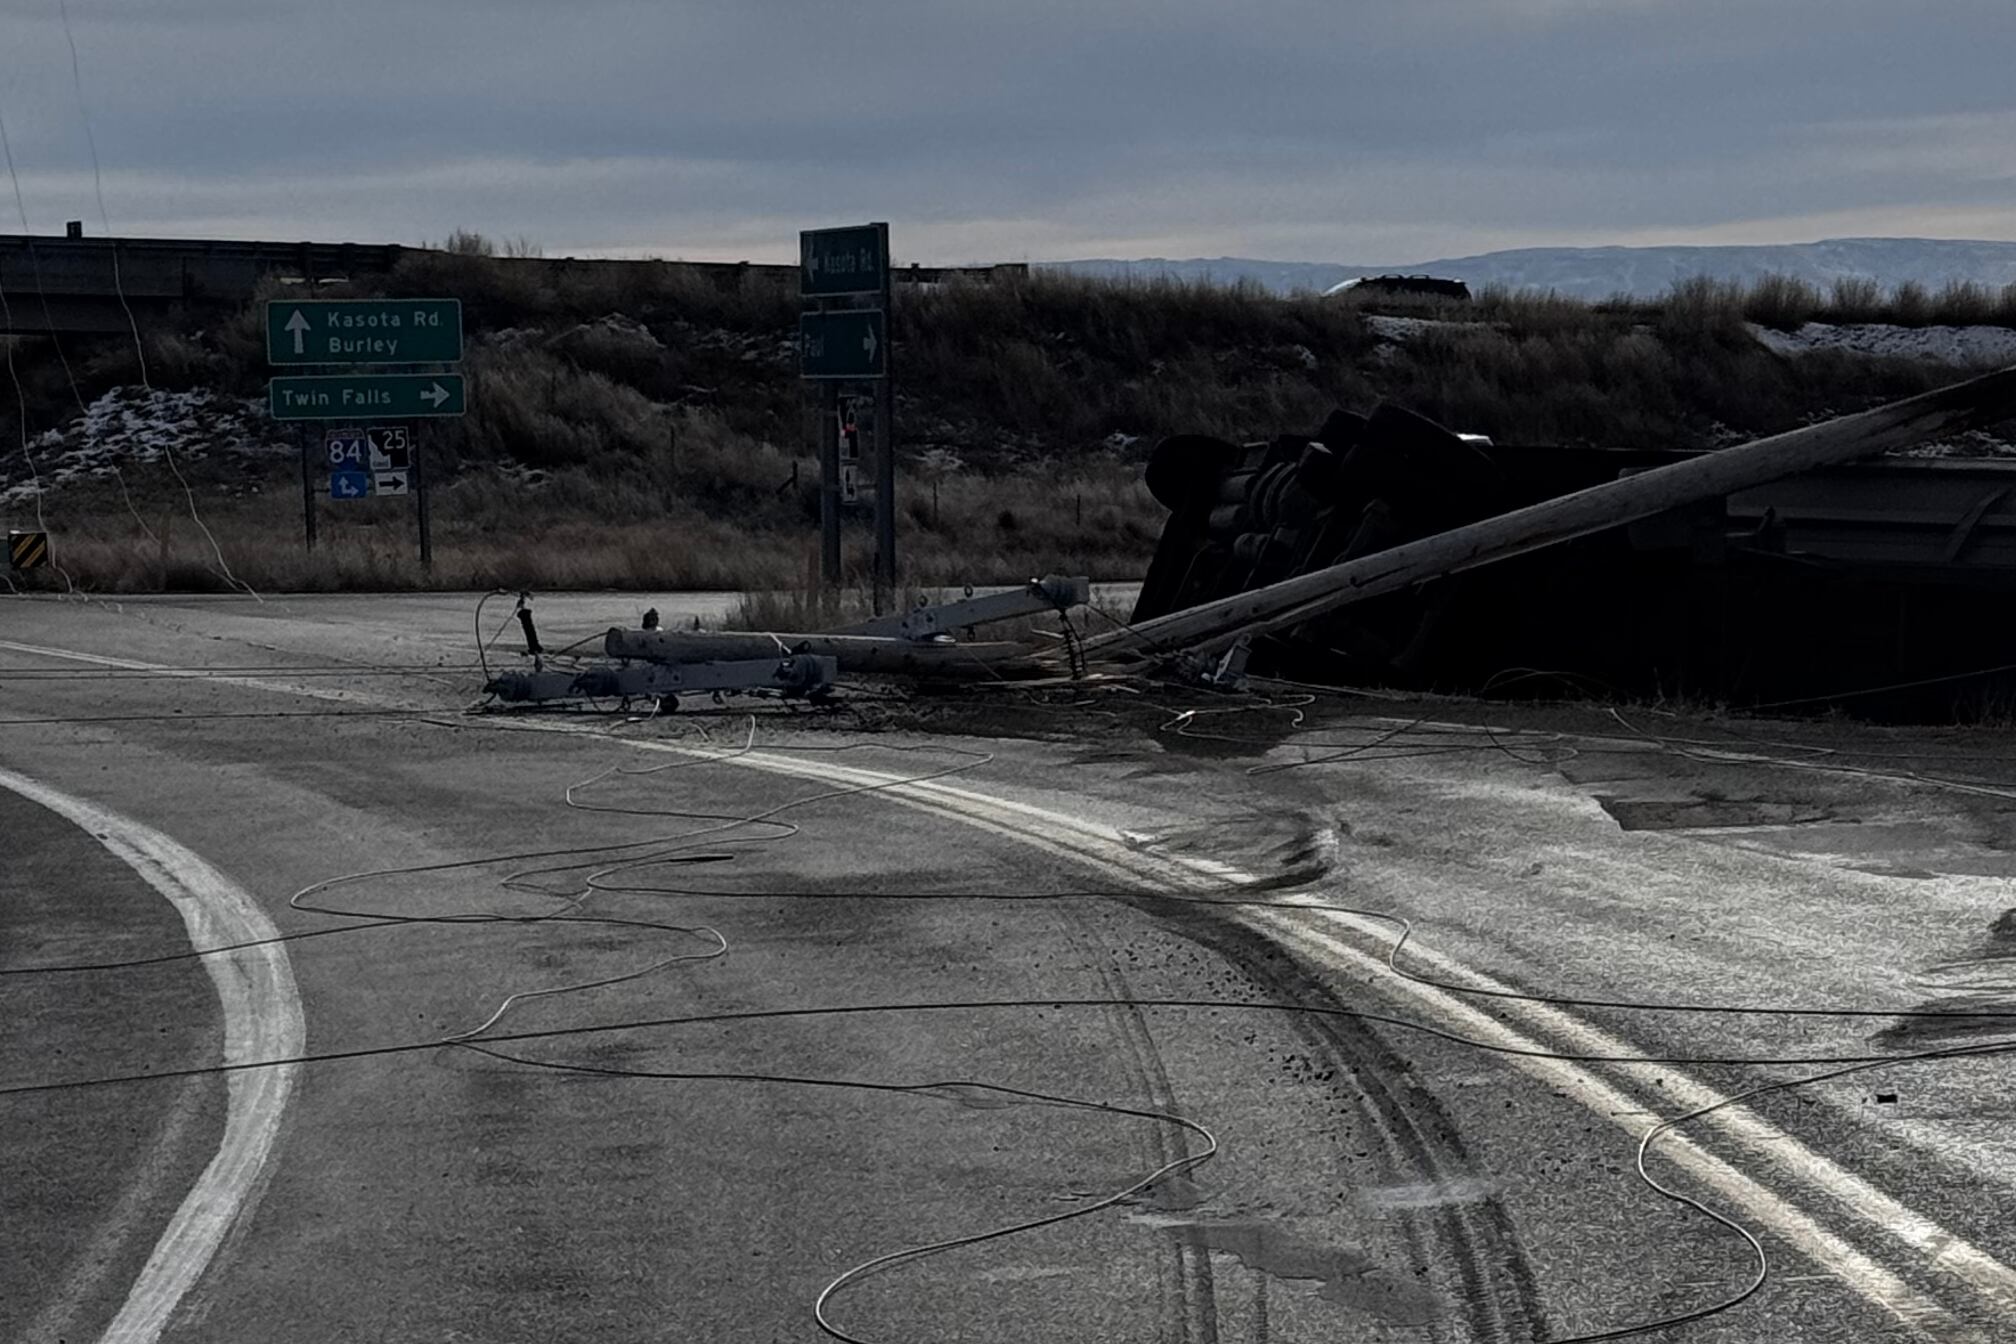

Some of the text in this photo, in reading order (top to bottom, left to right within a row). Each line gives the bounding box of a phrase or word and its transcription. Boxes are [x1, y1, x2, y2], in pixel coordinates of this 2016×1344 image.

[327, 311, 401, 328] Kasota
[328, 336, 399, 356] Burley
[281, 388, 392, 406] Twin Falls
[382, 429, 406, 450] 25
[329, 440, 362, 464] 84
